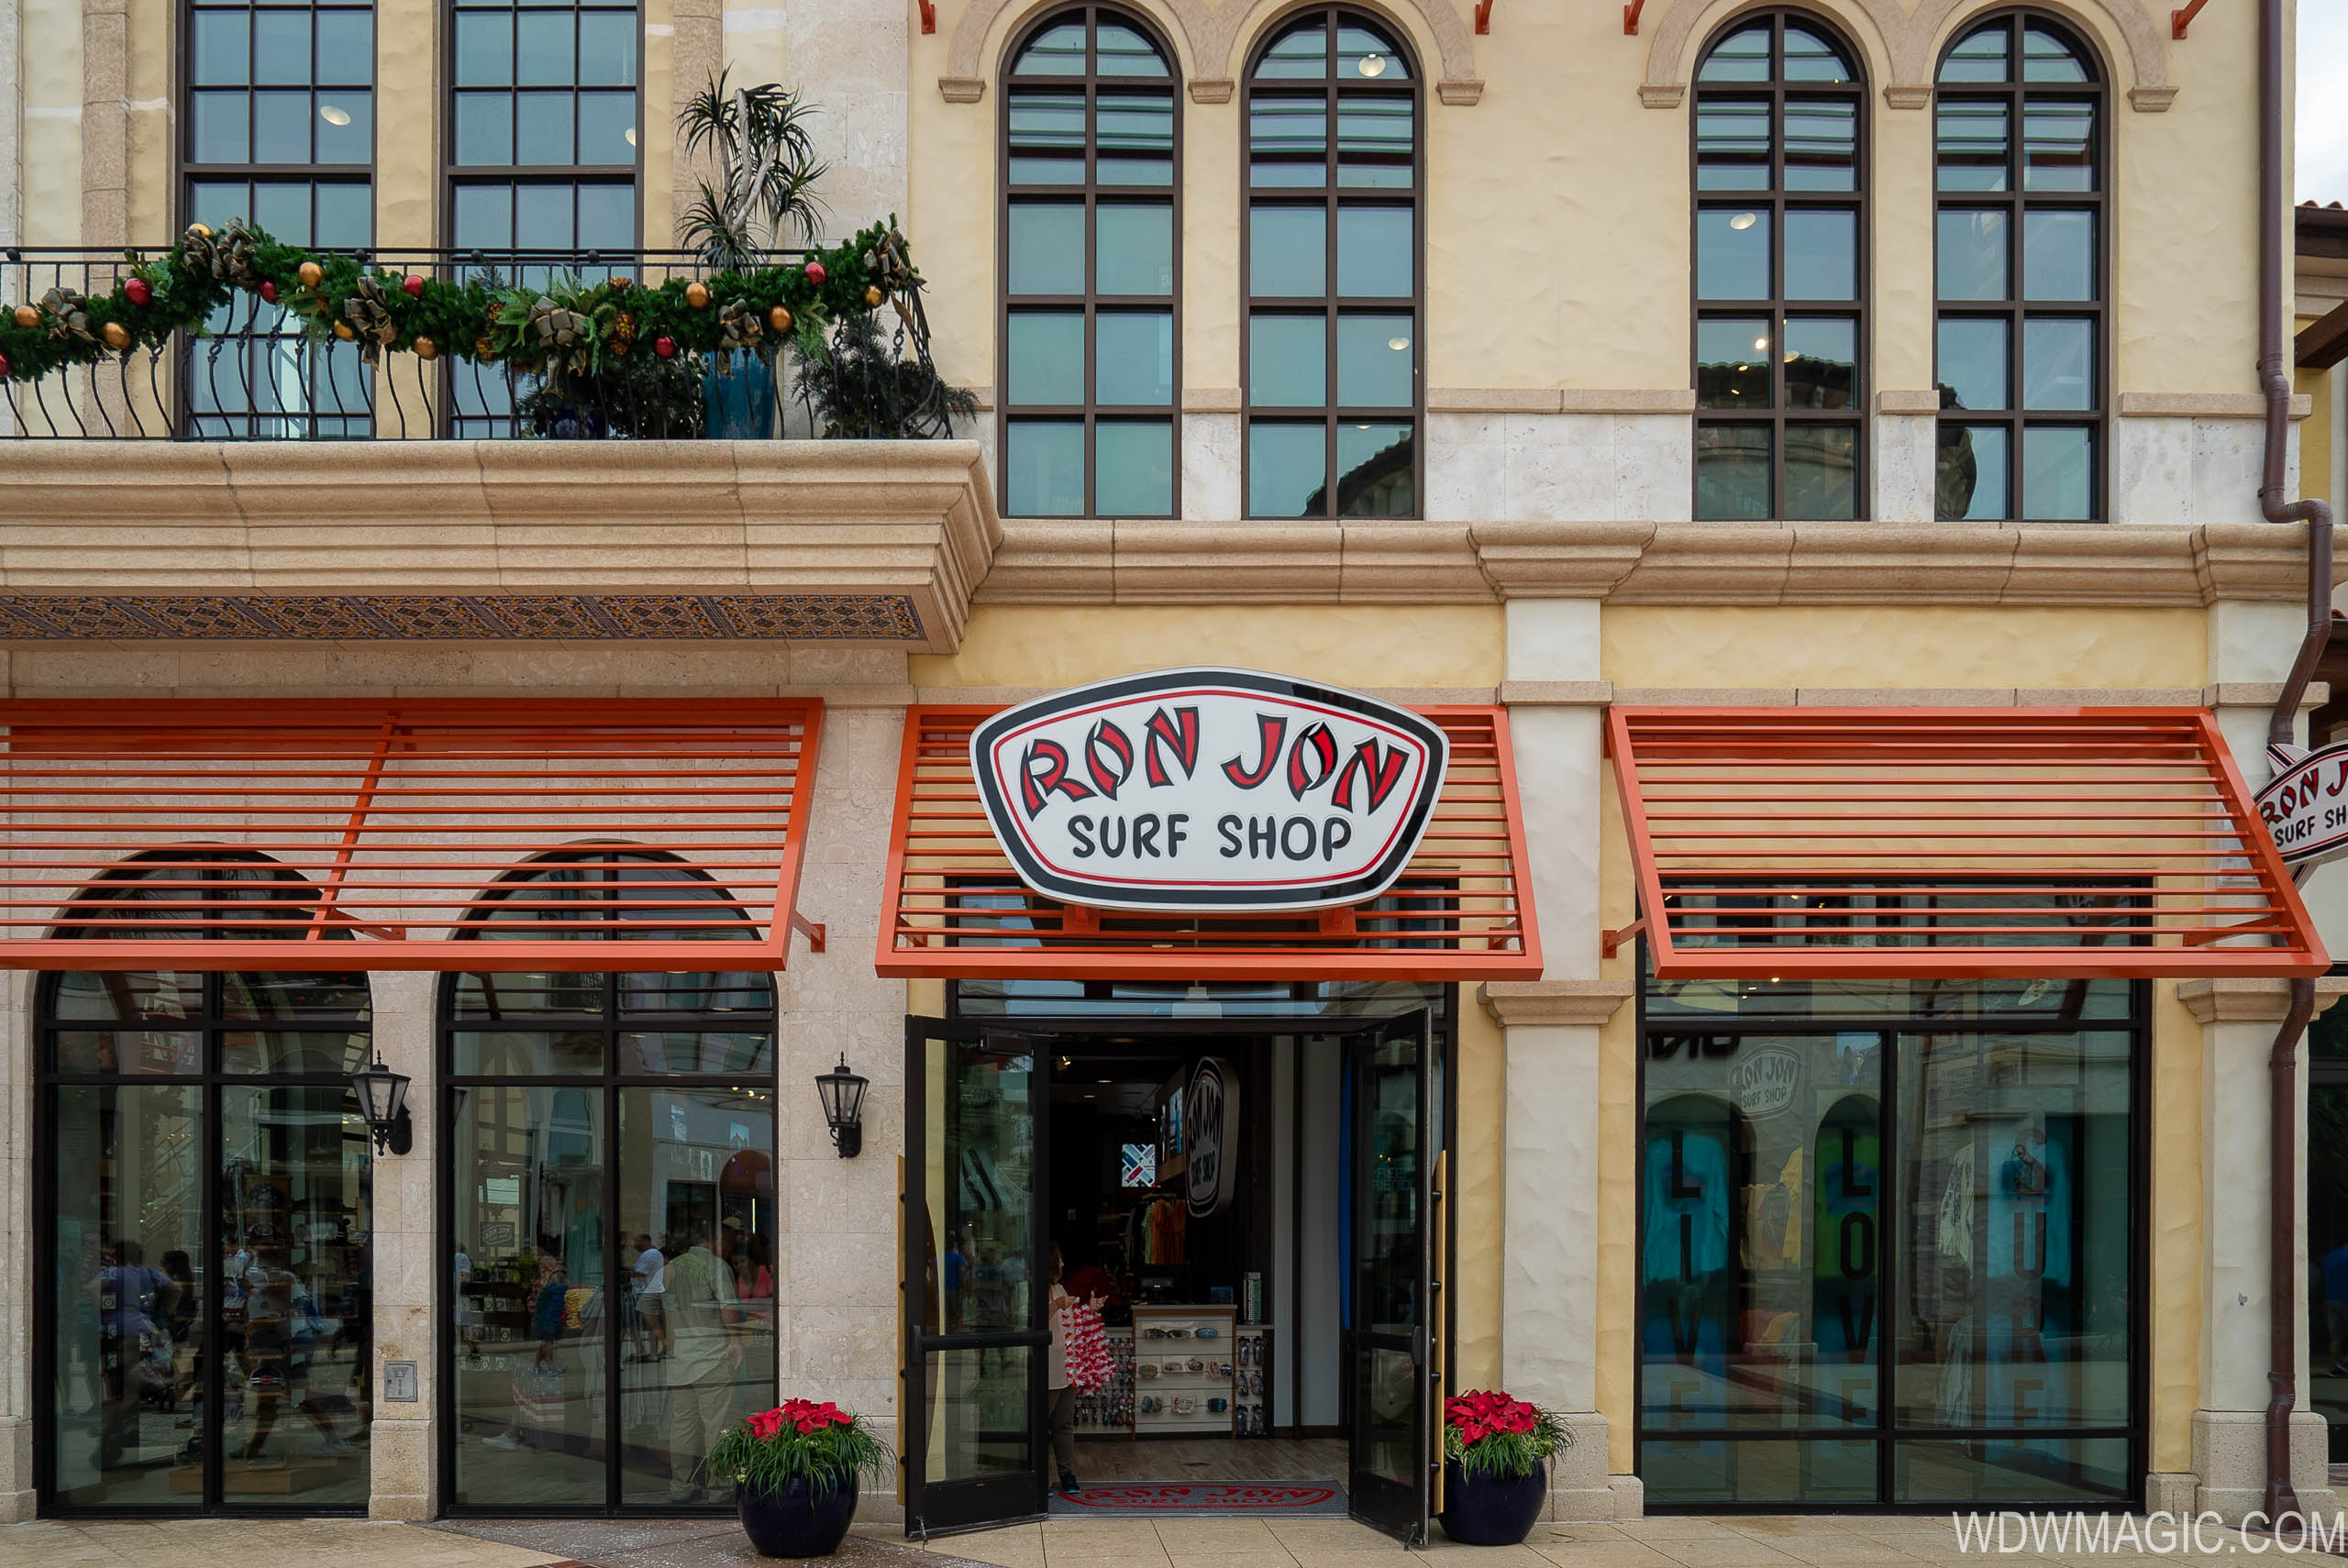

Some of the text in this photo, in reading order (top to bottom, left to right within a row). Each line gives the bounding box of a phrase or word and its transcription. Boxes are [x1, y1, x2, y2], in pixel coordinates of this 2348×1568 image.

[1019, 705, 1411, 822] RON JON
[2260, 767, 2319, 829] RON
[1067, 812, 1353, 862] SURF SHOP
[2274, 814, 2316, 847] SURF
[1765, 1056, 1796, 1085] JON
[1764, 1085, 1787, 1103] SHOP
[1084, 1488, 1315, 1500] RON JON
